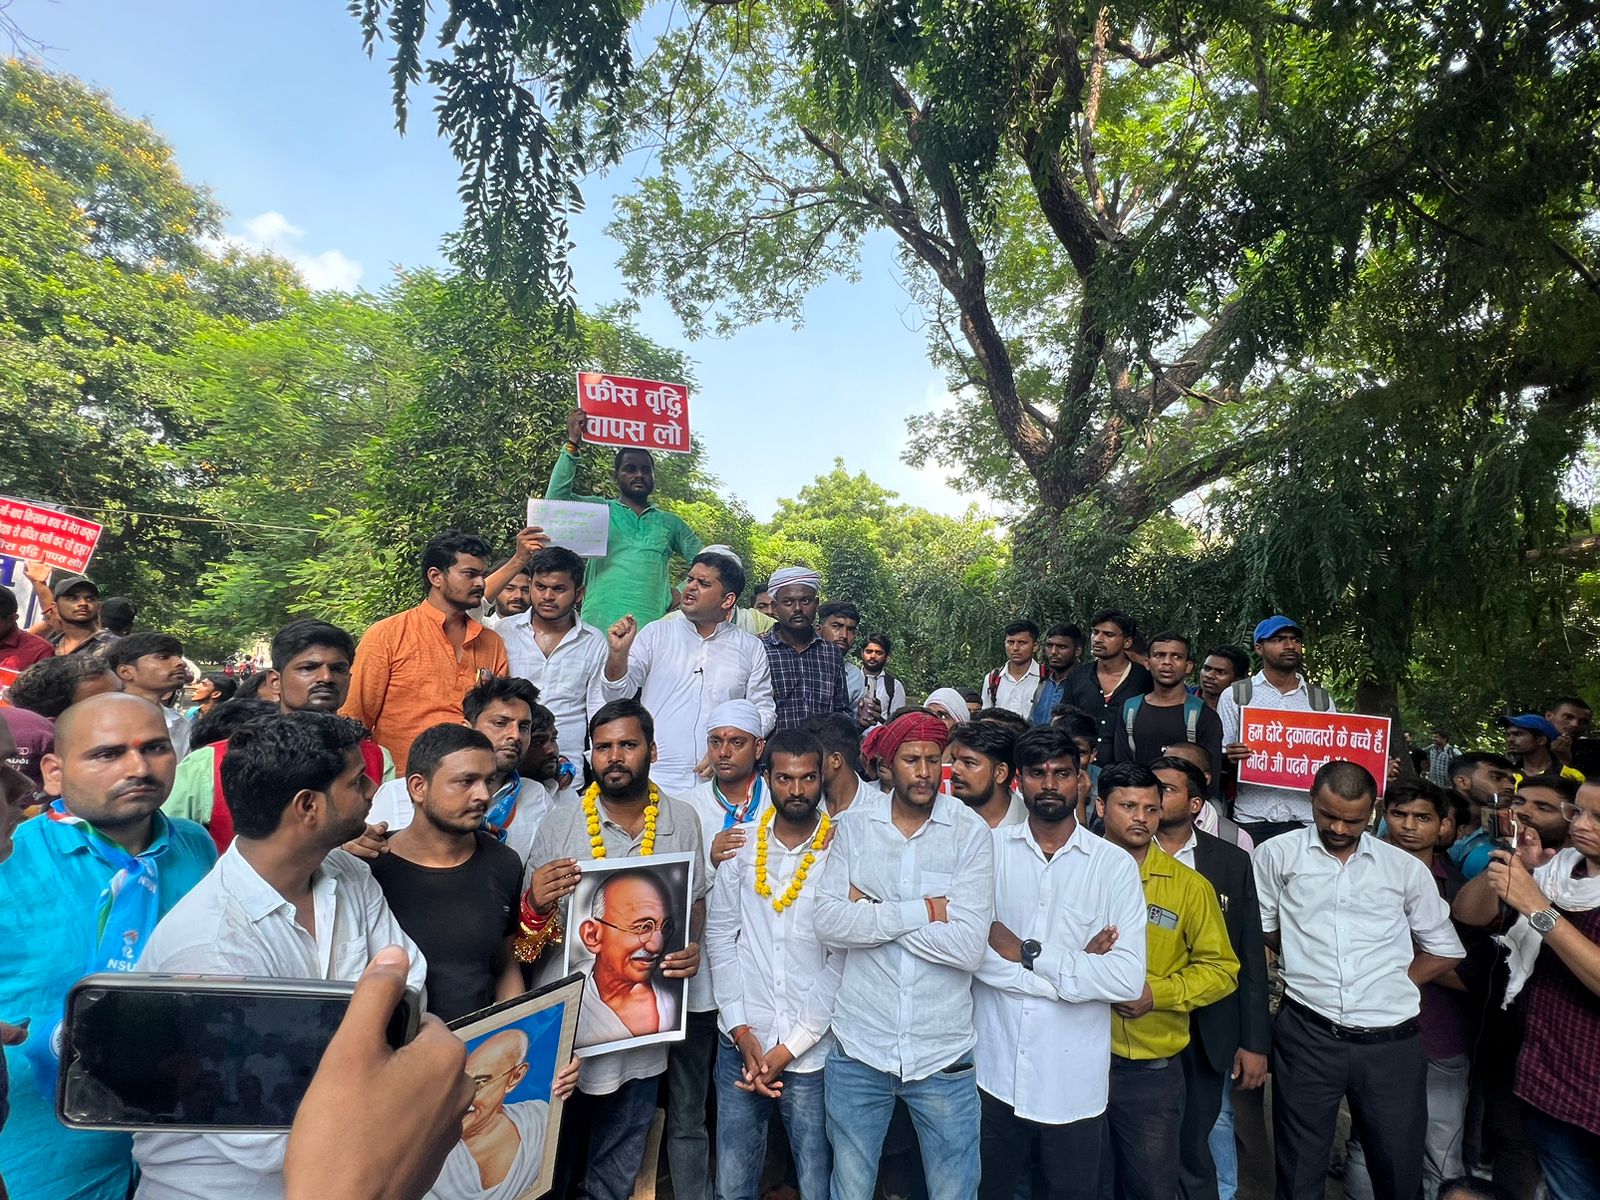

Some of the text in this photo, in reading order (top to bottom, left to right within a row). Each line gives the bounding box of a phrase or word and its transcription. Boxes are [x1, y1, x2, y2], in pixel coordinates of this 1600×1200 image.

[585, 379, 683, 418] फीस वृद्धि
[586, 415, 683, 446] वापस लो
[0, 538, 17, 551] ीस
[1248, 723, 1264, 742] हम
[1266, 720, 1284, 743] छोटे
[1285, 724, 1334, 748] दुकानदारों
[1336, 726, 1349, 748] के
[1350, 728, 1372, 750] बच्चे
[1246, 749, 1269, 771] मोदी
[1270, 751, 1284, 773] जी
[1286, 754, 1309, 777] पढ़ने
